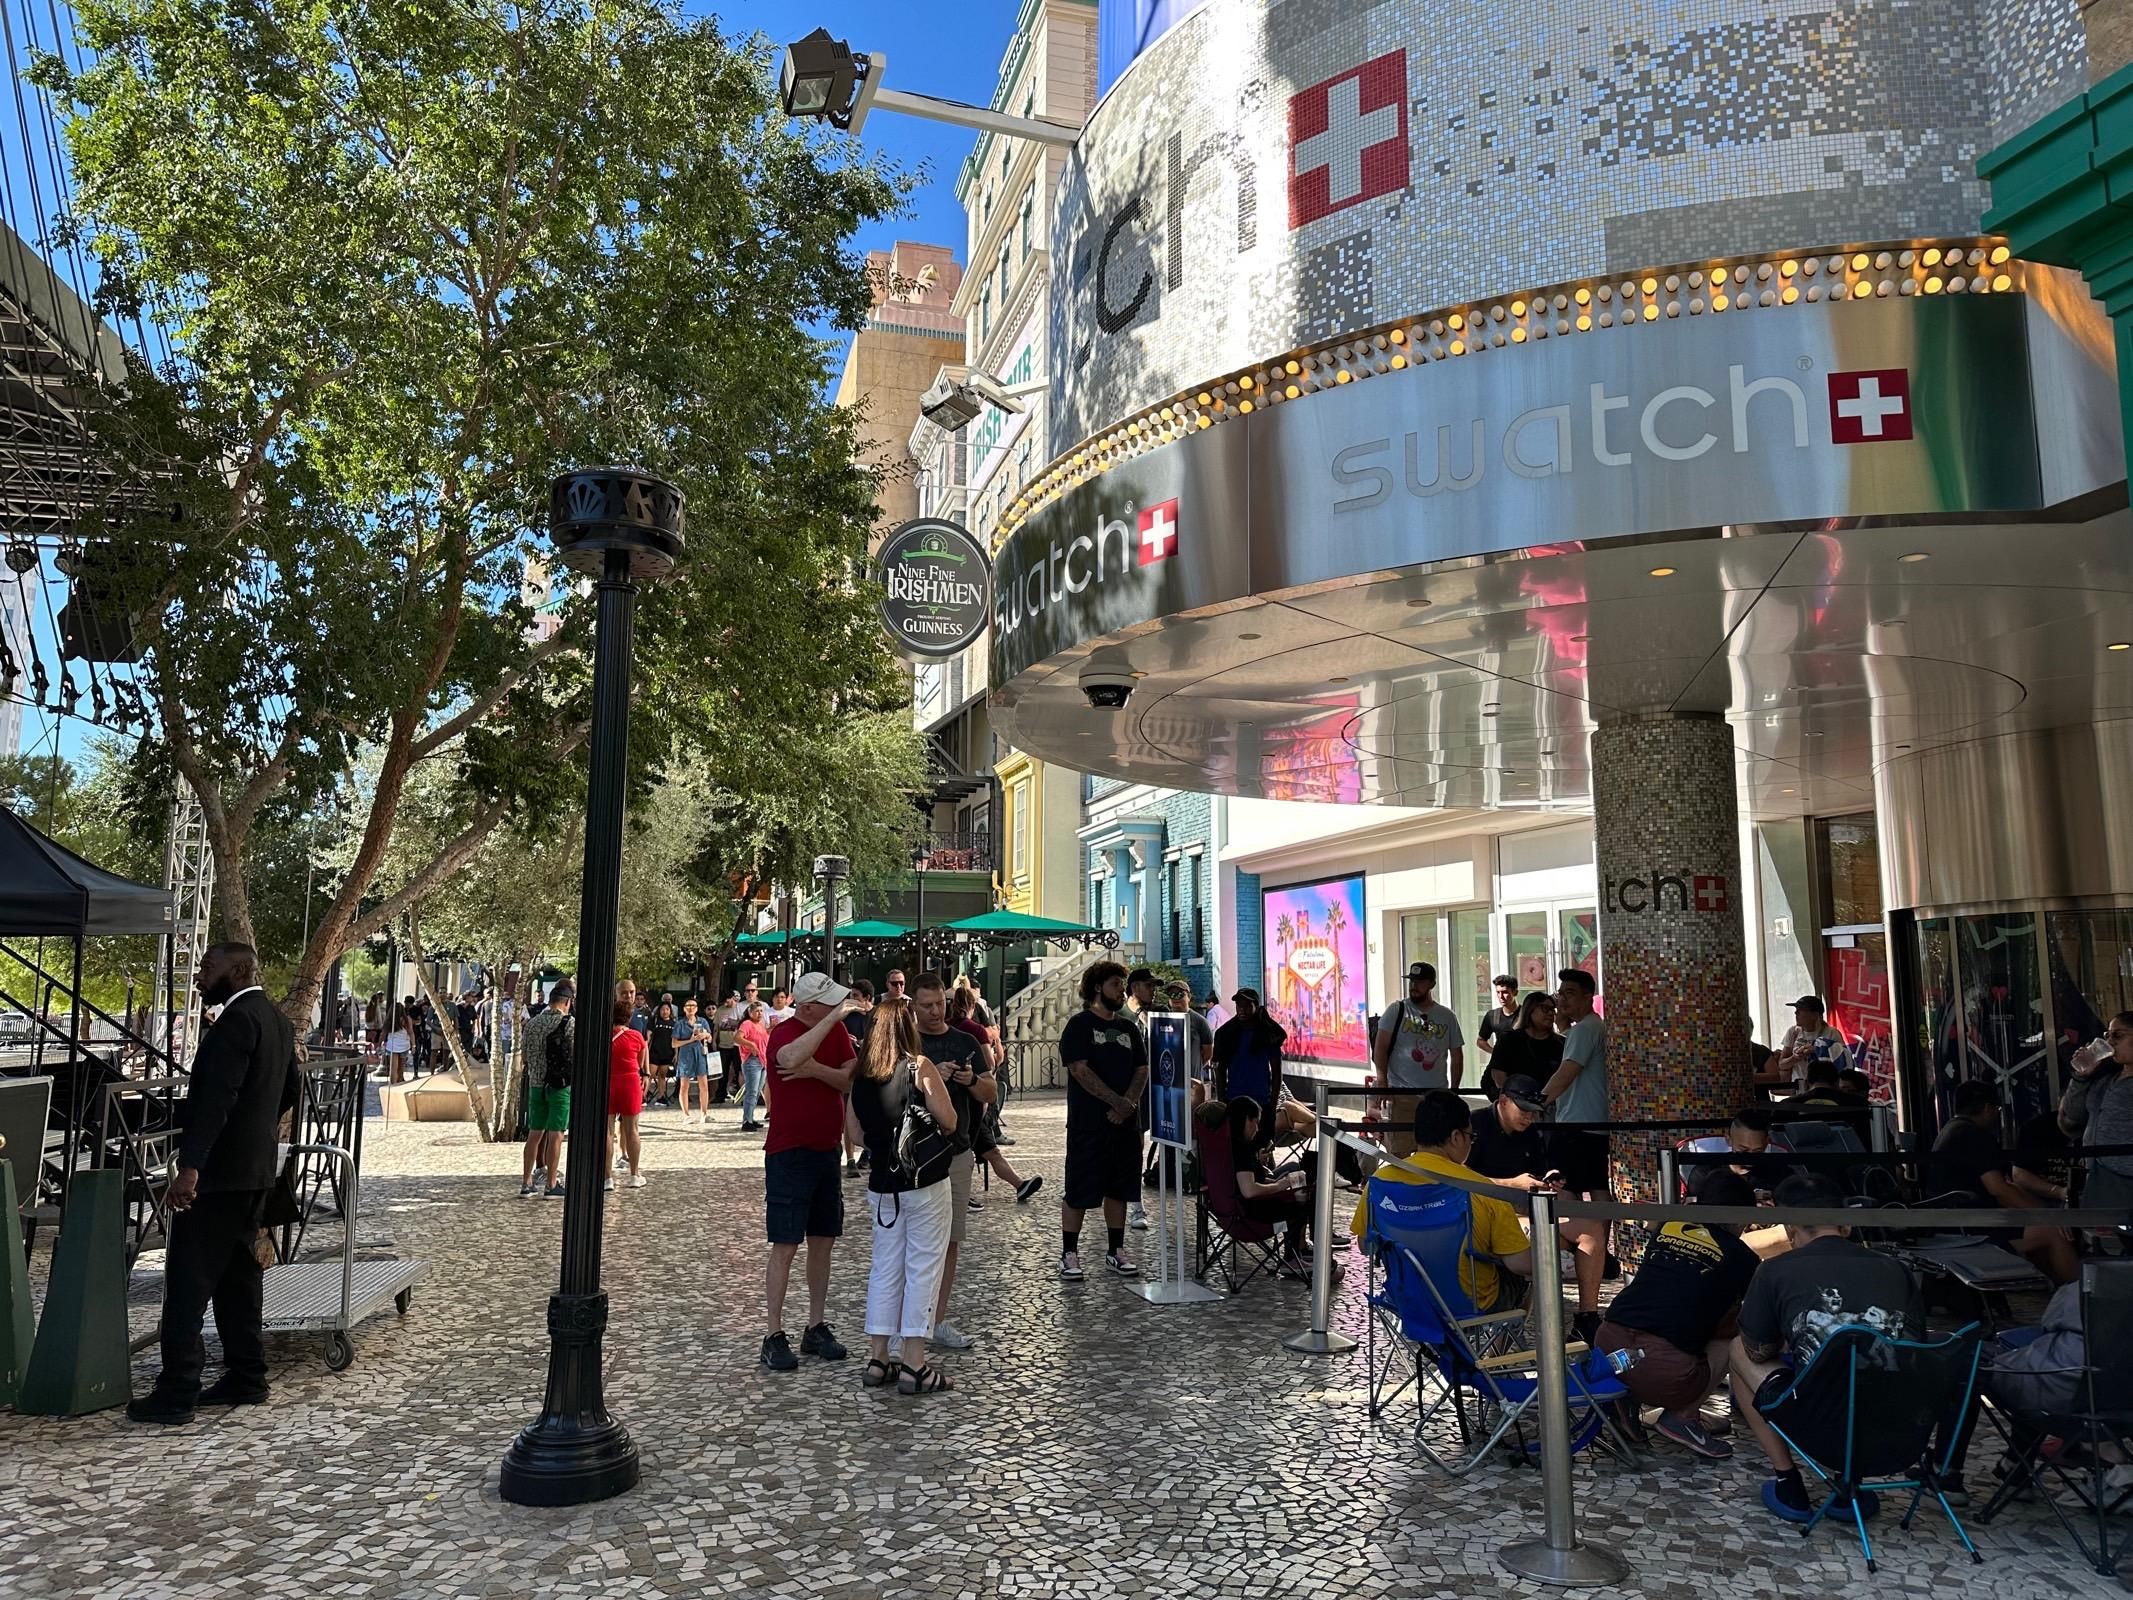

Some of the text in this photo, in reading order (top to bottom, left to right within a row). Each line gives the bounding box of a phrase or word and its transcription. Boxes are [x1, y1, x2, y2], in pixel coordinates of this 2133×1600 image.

[972, 407, 1001, 479] IRISH
[1332, 363, 1809, 514] swatch
[887, 567, 983, 606] IRISHMEN
[897, 562, 956, 582] NINE FINE
[995, 514, 1130, 648] swatch
[903, 618, 963, 635] GUINNESS
[1600, 869, 1688, 914] tch
[1656, 1234, 1721, 1262] Generations
